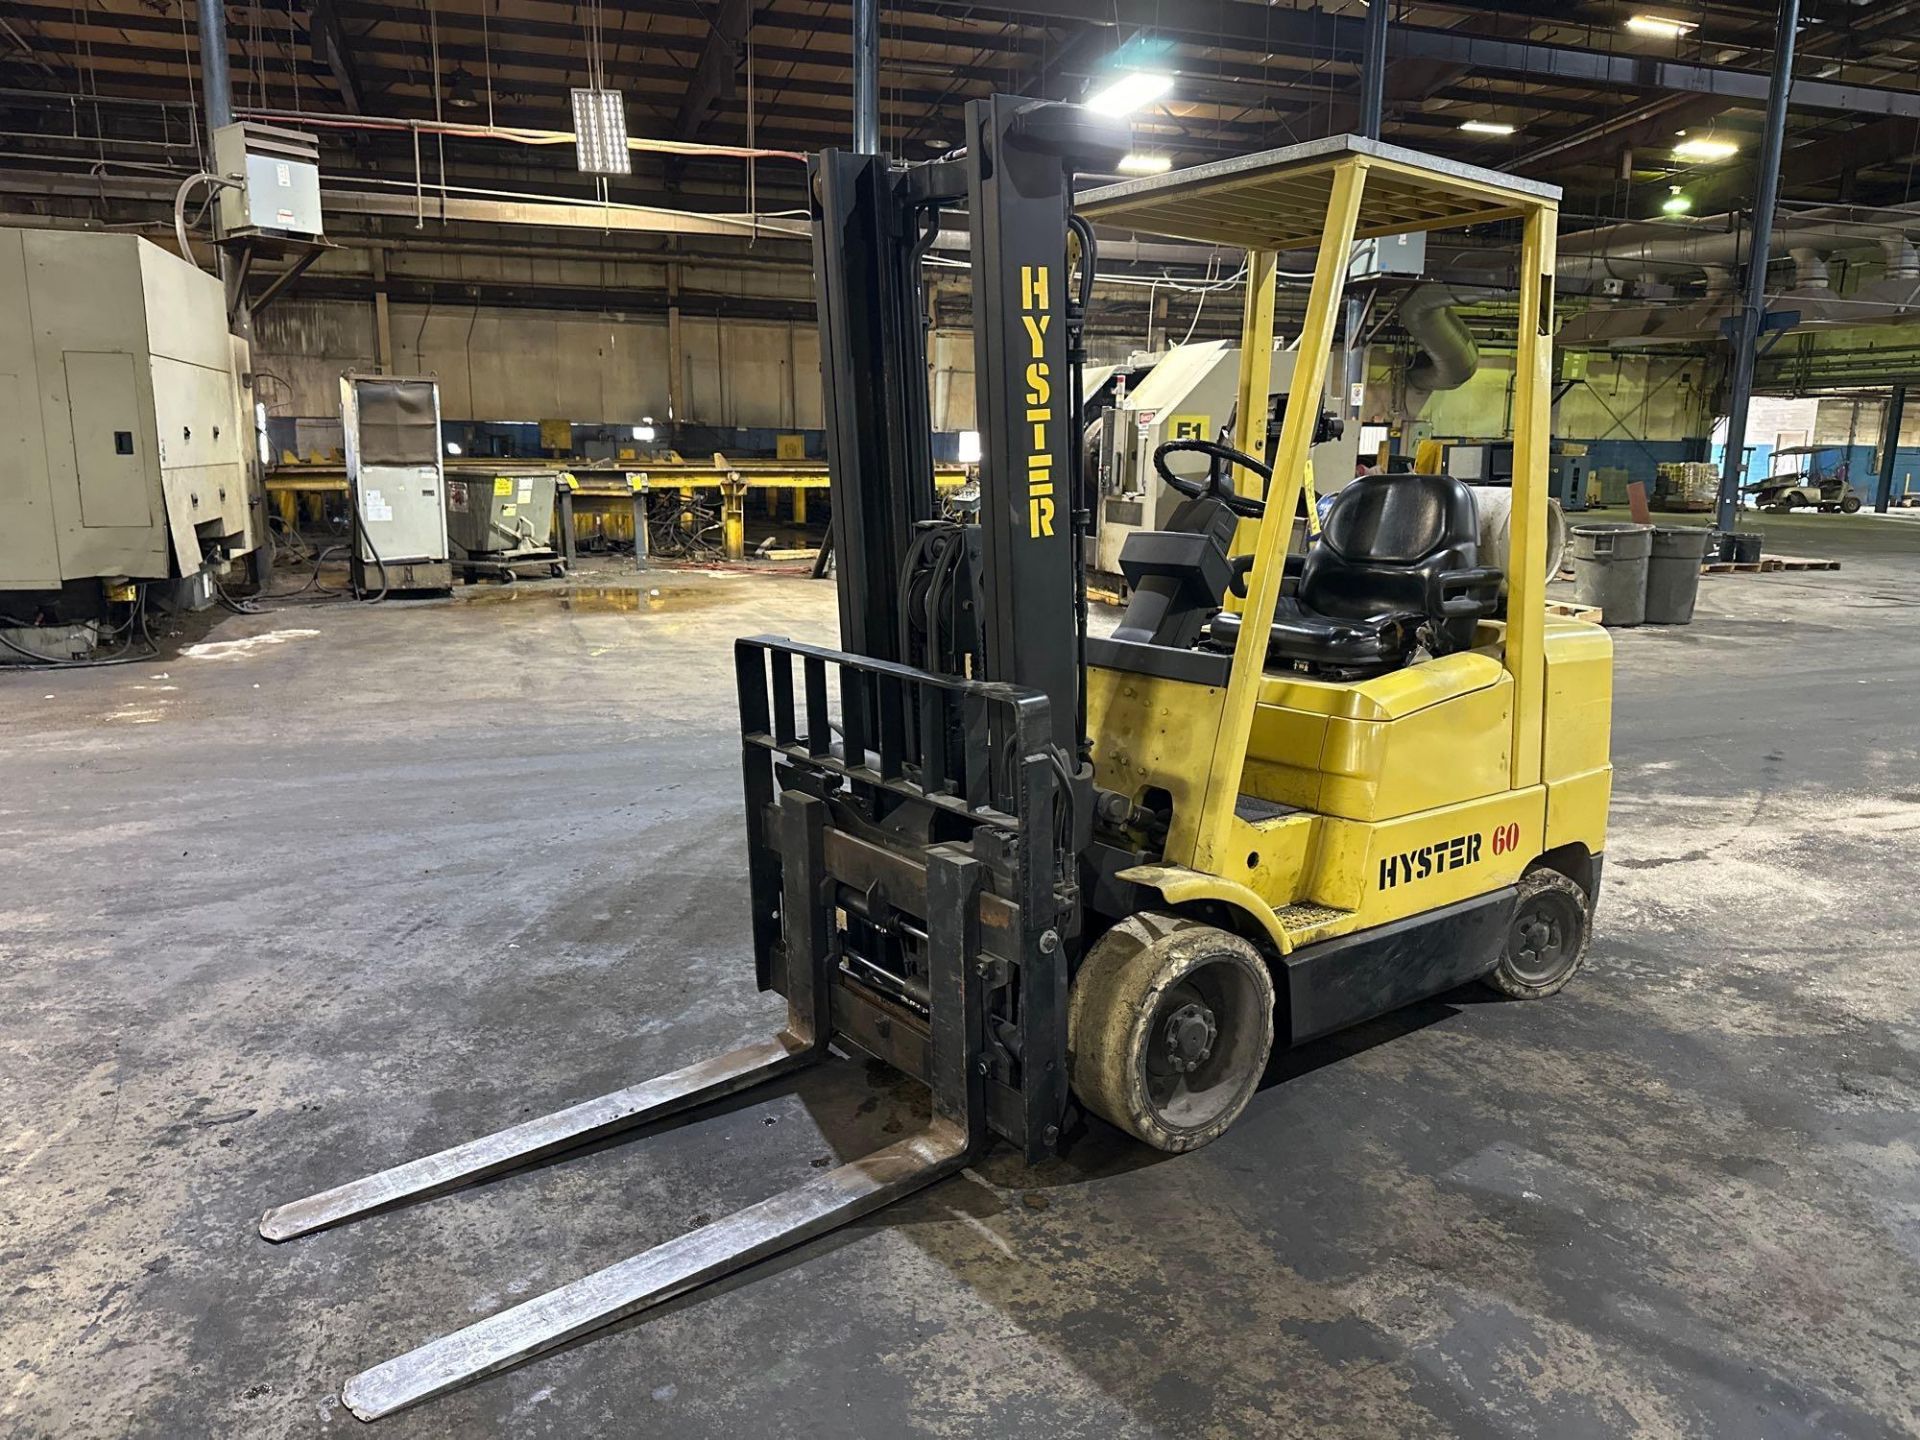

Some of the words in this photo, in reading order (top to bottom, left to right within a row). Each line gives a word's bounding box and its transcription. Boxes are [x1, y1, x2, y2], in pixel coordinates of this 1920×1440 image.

[1021, 266, 1055, 538] HYSTER
[1379, 833, 1482, 890] HYSTER
[1492, 822, 1520, 856] 60
